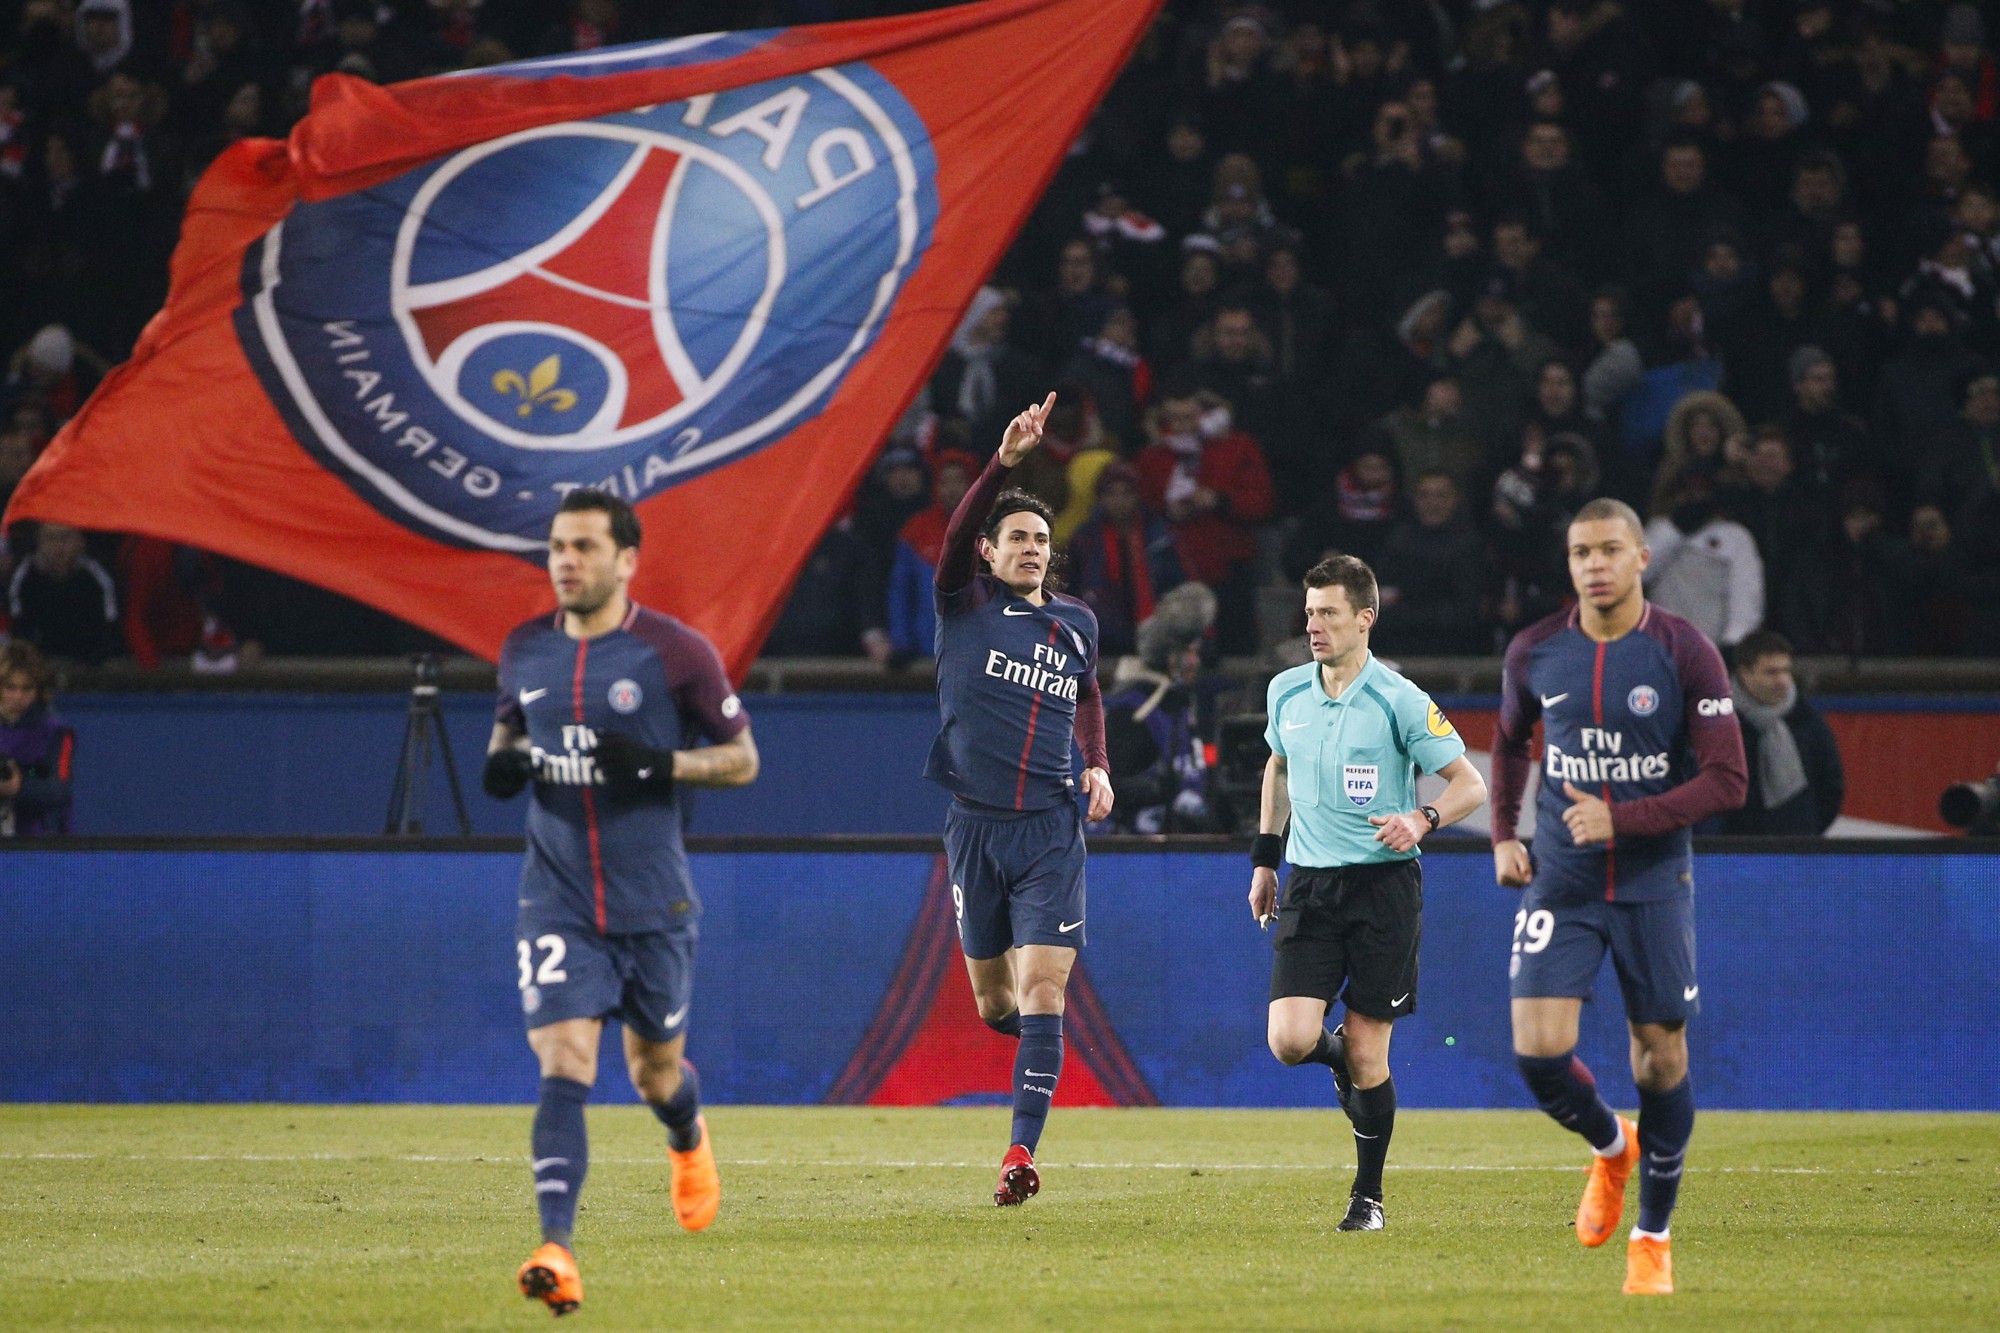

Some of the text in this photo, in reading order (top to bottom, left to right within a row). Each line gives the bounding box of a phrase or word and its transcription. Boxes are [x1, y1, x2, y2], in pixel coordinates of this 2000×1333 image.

[1033, 643, 1067, 671] Fly
[985, 649, 1078, 700] Emirate
[1581, 728, 1622, 755] Fly
[1547, 744, 1670, 782] Emirates
[1348, 780, 1373, 790] FIFA
[952, 884, 963, 919] 9
